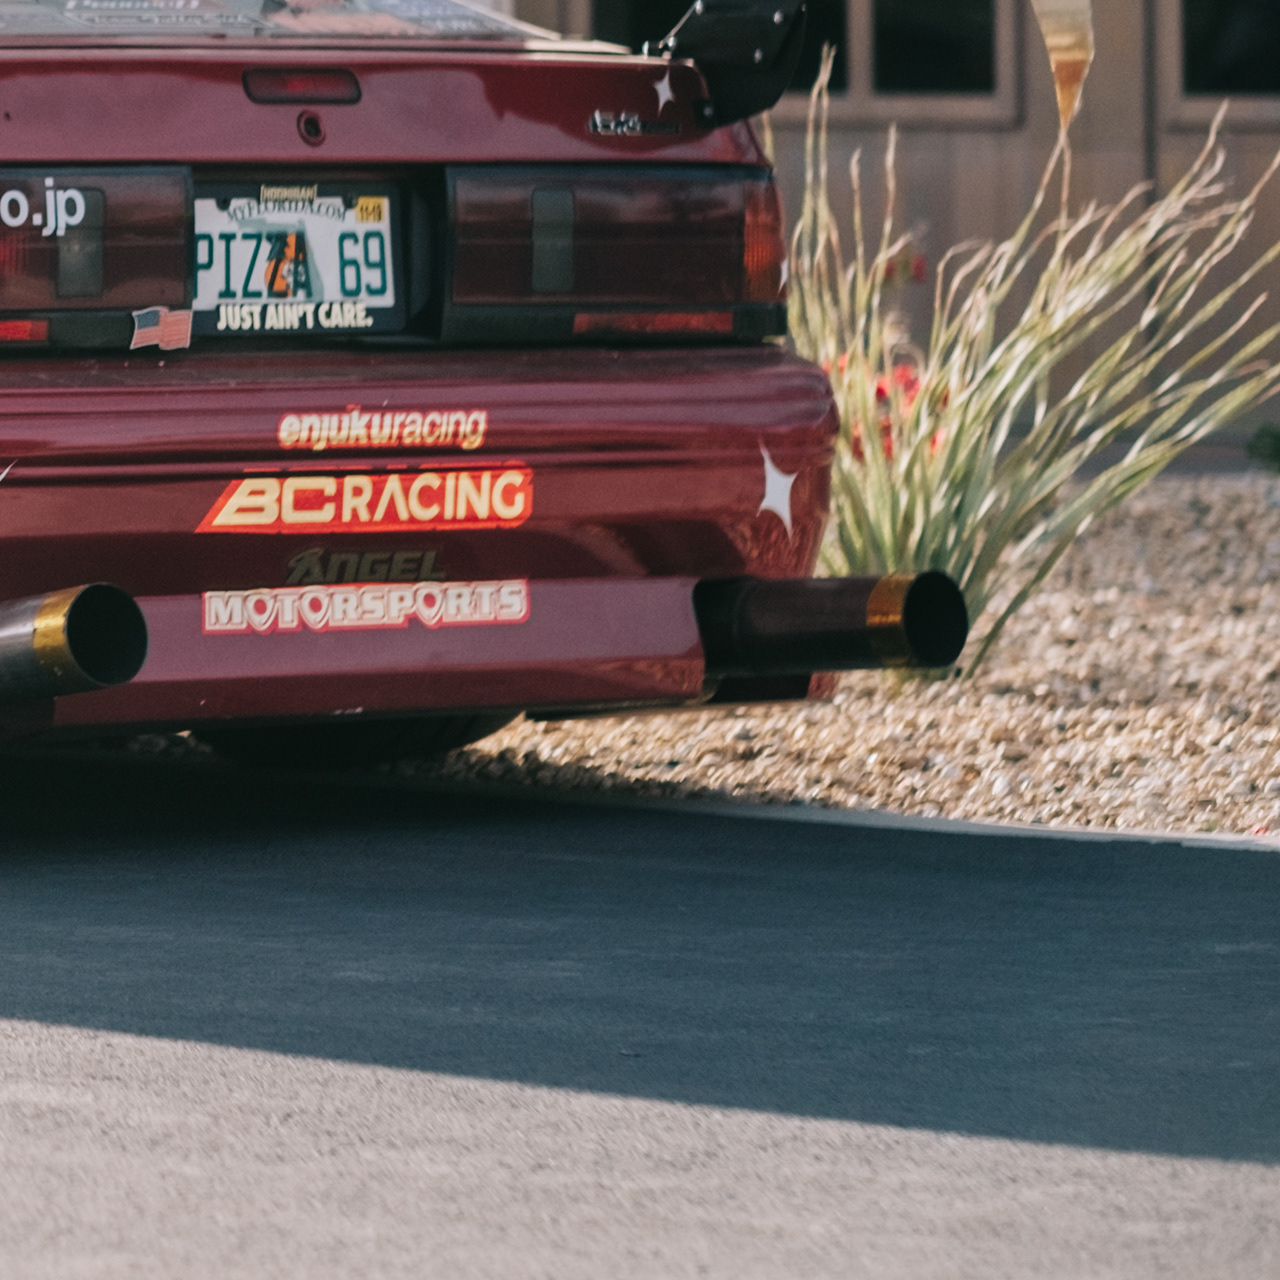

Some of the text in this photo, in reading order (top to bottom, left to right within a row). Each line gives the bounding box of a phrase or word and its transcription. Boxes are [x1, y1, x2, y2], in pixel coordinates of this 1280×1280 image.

[192, 230, 387, 298] PIZZA 69
[217, 302, 373, 331] JUST AIN'T CARE.
[279, 411, 487, 450] enjukuracing
[286, 547, 446, 584] ANGEL
[204, 579, 528, 631] MOTORSPORTS
